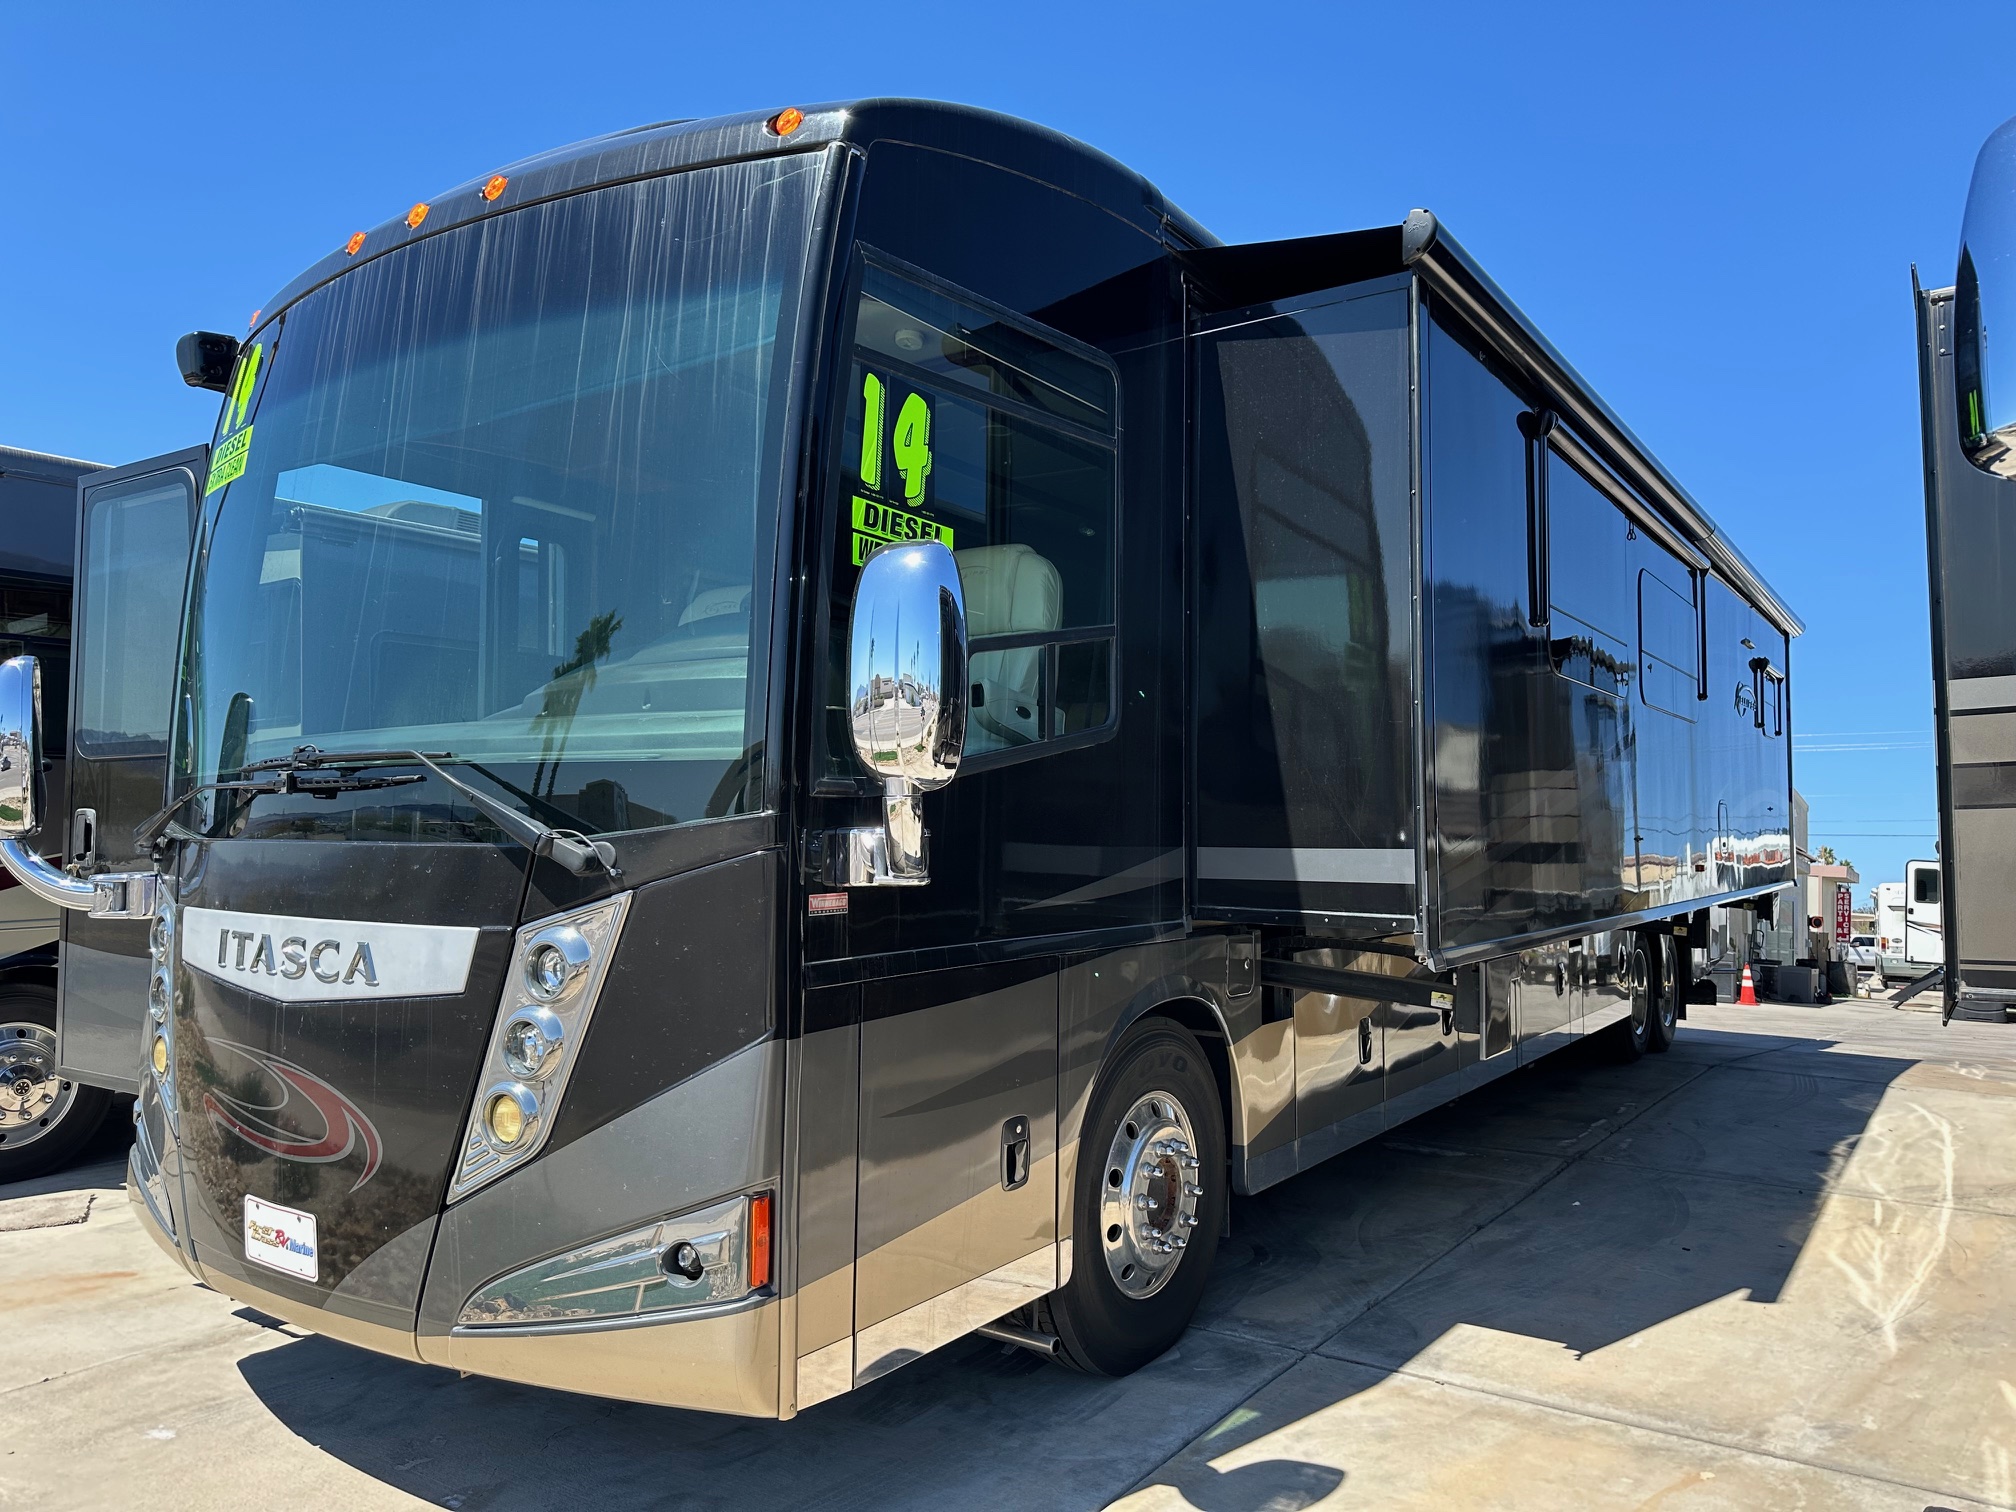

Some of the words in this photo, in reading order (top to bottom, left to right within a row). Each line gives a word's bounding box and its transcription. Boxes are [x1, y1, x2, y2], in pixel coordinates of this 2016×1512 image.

[216, 430, 248, 465] DIESEL
[861, 373, 931, 503] 14
[811, 896, 847, 908] WINNEBAGO
[217, 928, 380, 987] ITASCA
[275, 1229, 290, 1248] RV
[289, 1237, 314, 1258] Marine
